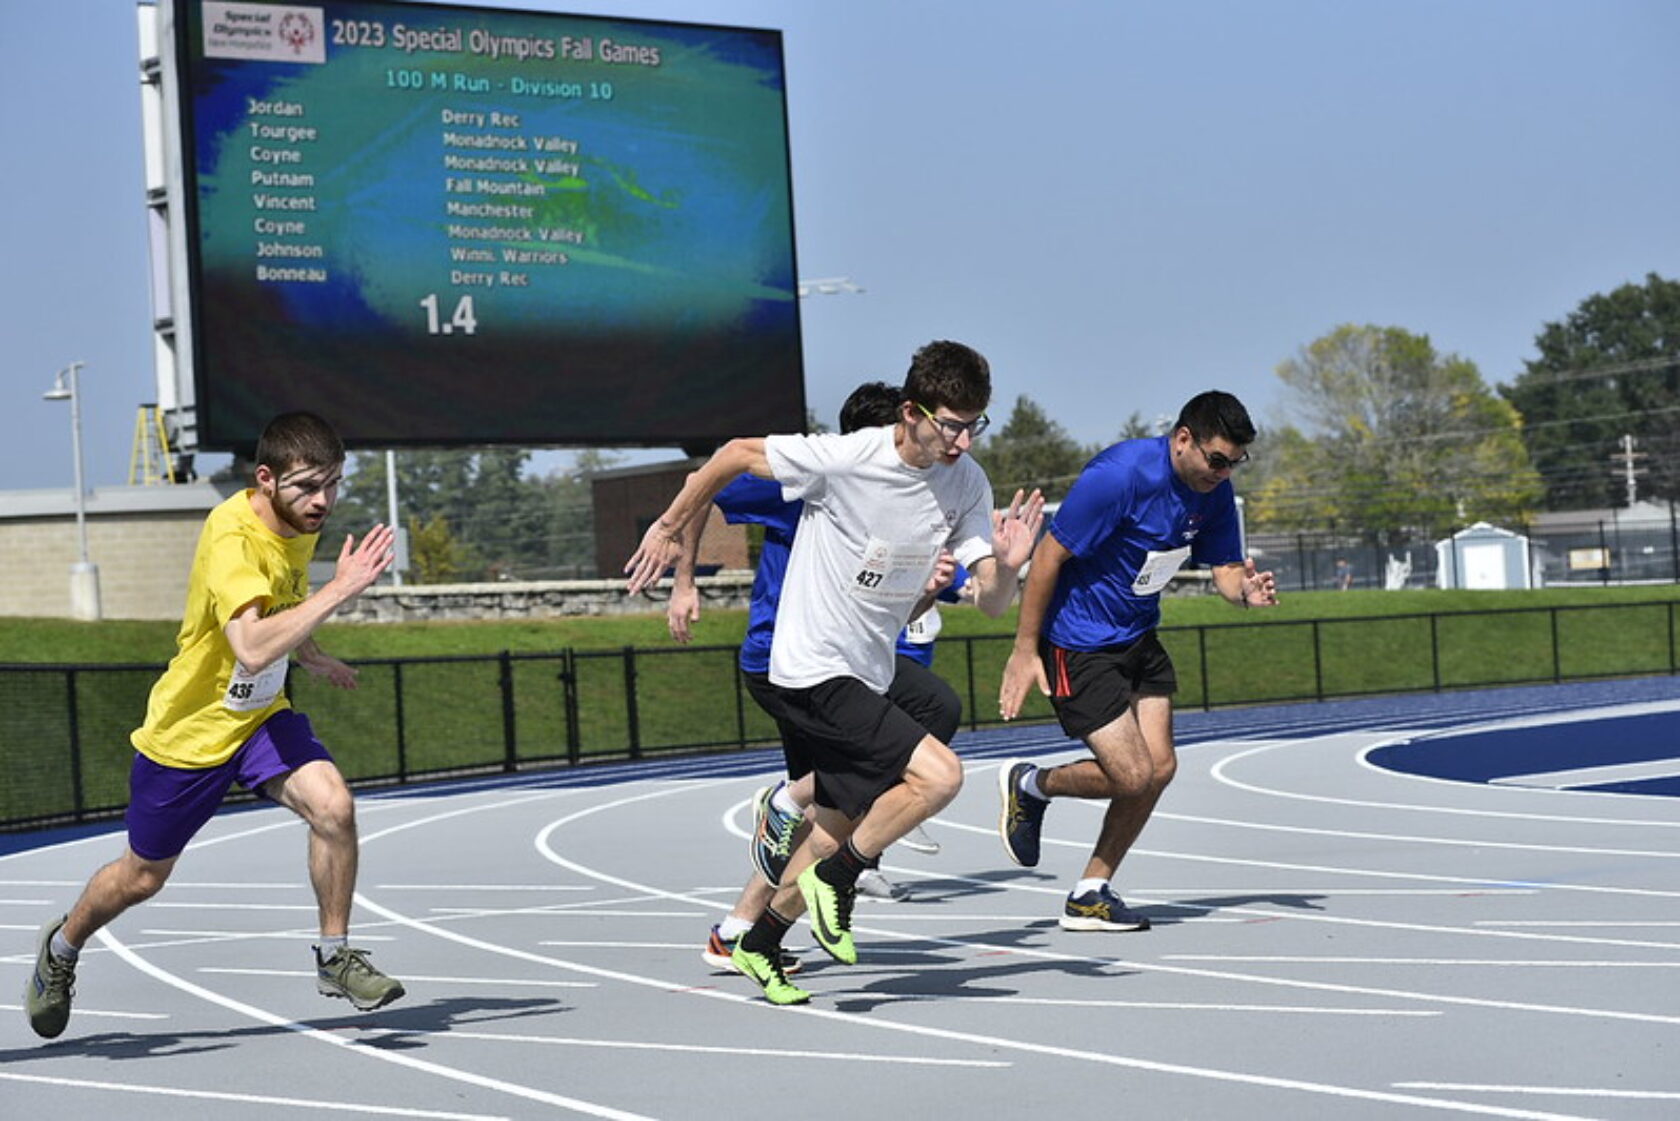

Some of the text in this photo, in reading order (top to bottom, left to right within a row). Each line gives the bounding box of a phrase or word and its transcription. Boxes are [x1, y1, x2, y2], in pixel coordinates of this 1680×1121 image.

[332, 20, 660, 66] 2023 Special Olympics Fall Games
[387, 70, 422, 88] 100
[431, 72, 447, 89] M
[454, 74, 490, 91] Run
[511, 77, 582, 98] Division
[590, 82, 613, 100] 10
[248, 98, 302, 116] Jordan
[442, 109, 519, 127] Derry Rec
[250, 122, 317, 142] Tourgee
[443, 133, 578, 154] Monadnock Valley
[251, 146, 302, 163] Coyne
[444, 155, 579, 176] Monadnock Valley
[252, 170, 314, 186] Putnam
[446, 178, 545, 196] Fall Mountain
[253, 194, 316, 210] Vincent
[447, 202, 534, 218] Manchester
[254, 218, 305, 235] Coyne
[448, 224, 584, 244] Monadnock Valley
[256, 242, 323, 258] Johnson
[502, 249, 567, 264] Warriors
[256, 265, 327, 282] Bonneau
[451, 270, 528, 287] Derry Rec
[419, 293, 477, 335] 1.4
[856, 569, 883, 589] 427
